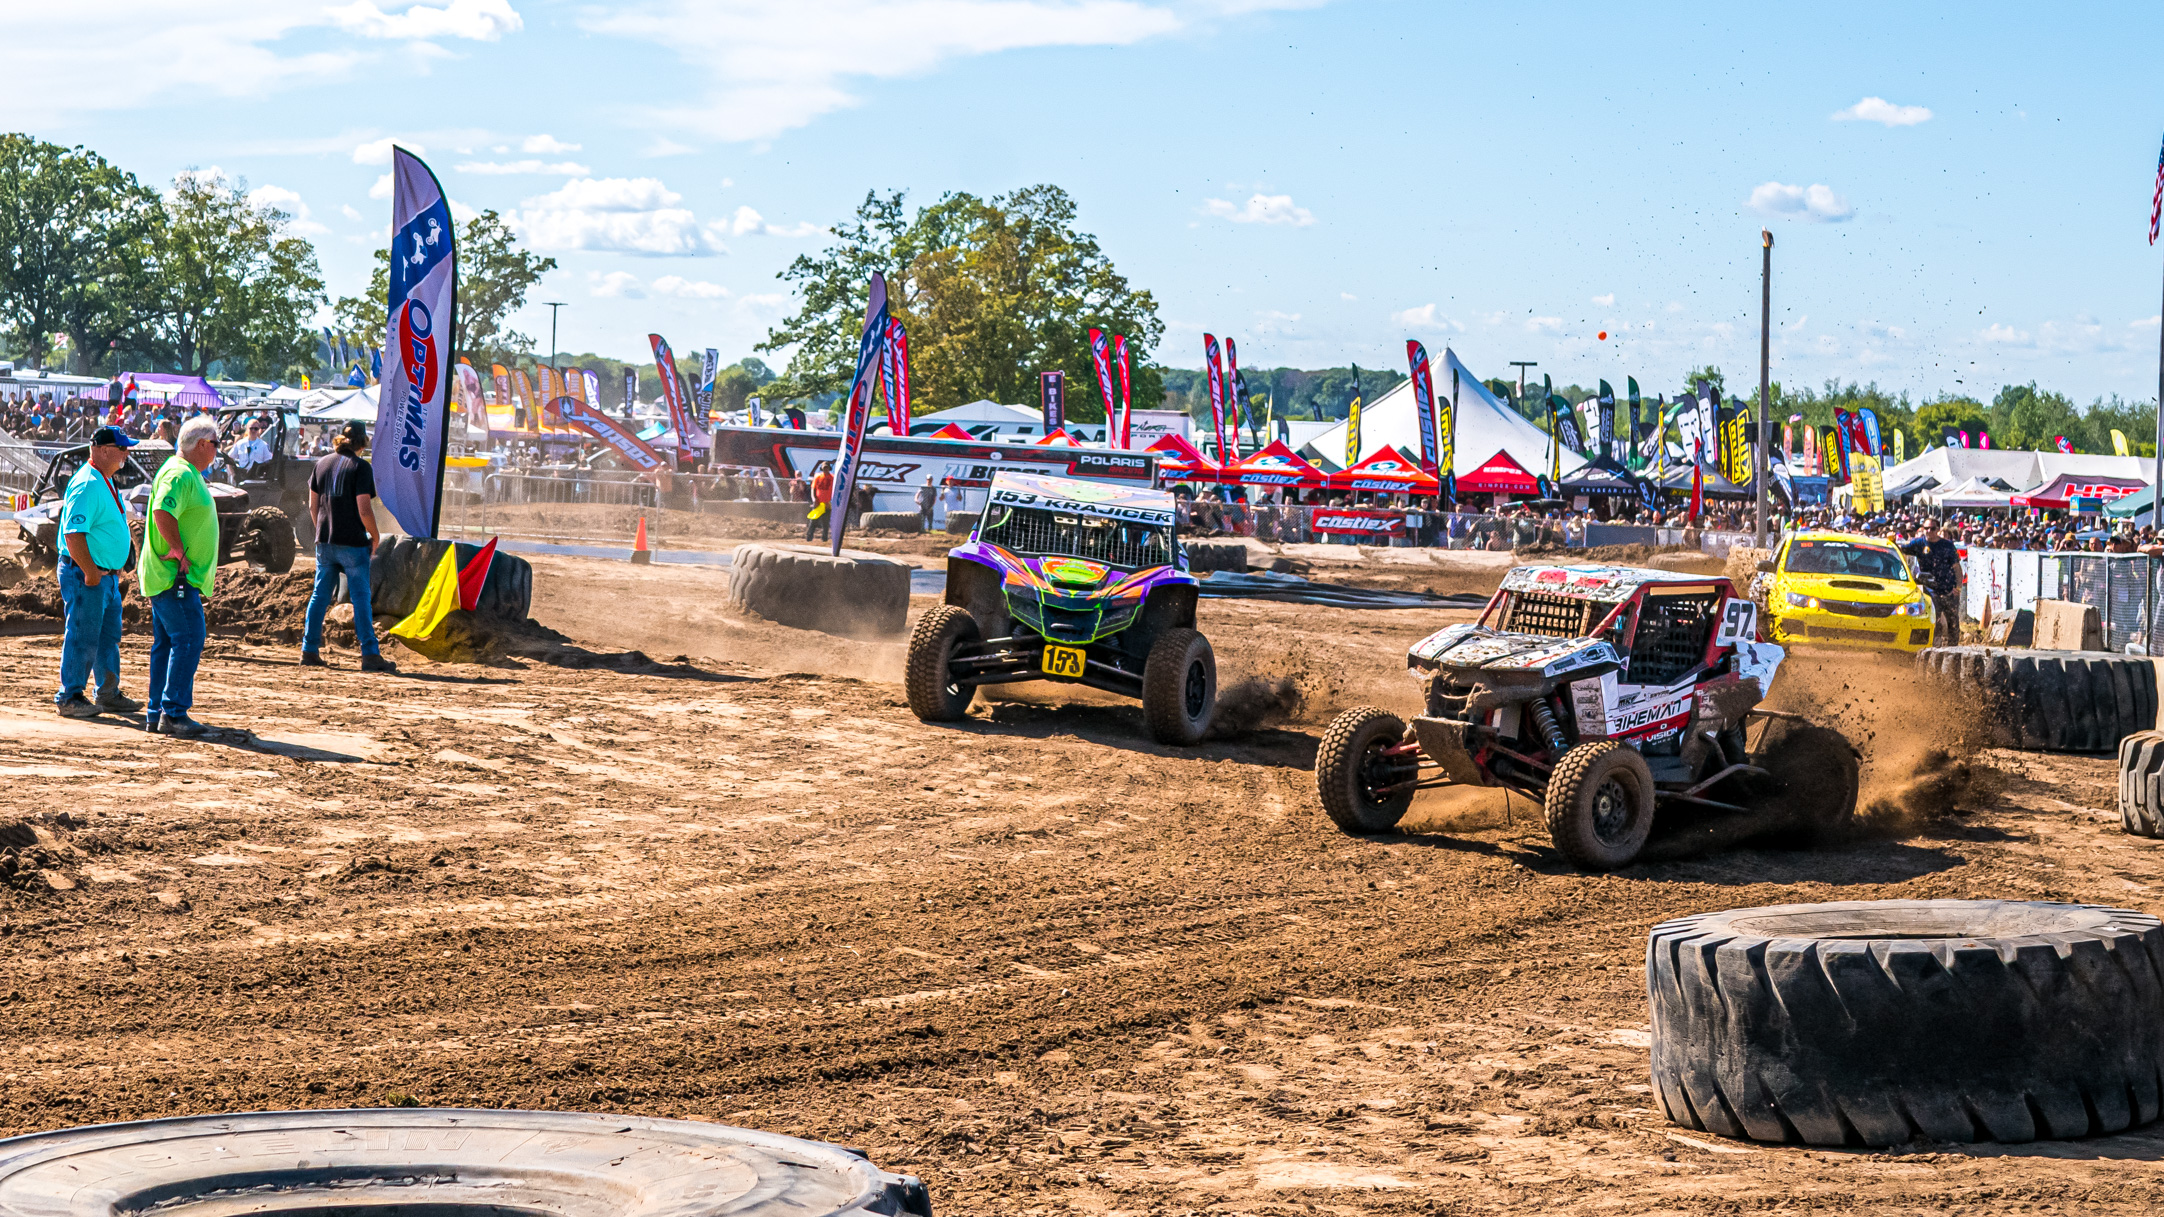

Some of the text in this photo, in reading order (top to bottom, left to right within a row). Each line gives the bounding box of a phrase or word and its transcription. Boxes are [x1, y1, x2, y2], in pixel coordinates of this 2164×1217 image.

[400, 298, 432, 472] OPTIMAS
[392, 391, 406, 457] POWERSPORTS
[1080, 455, 1145, 468] POLARIS
[1107, 466, 1144, 475] RACING
[1483, 466, 1522, 475] KIMPEX
[17, 494, 28, 511] 18
[992, 489, 1173, 524] 153 KRAJICEK
[1725, 602, 1753, 637] 97
[1046, 648, 1080, 674] 153
[1646, 726, 1678, 742] VISION
